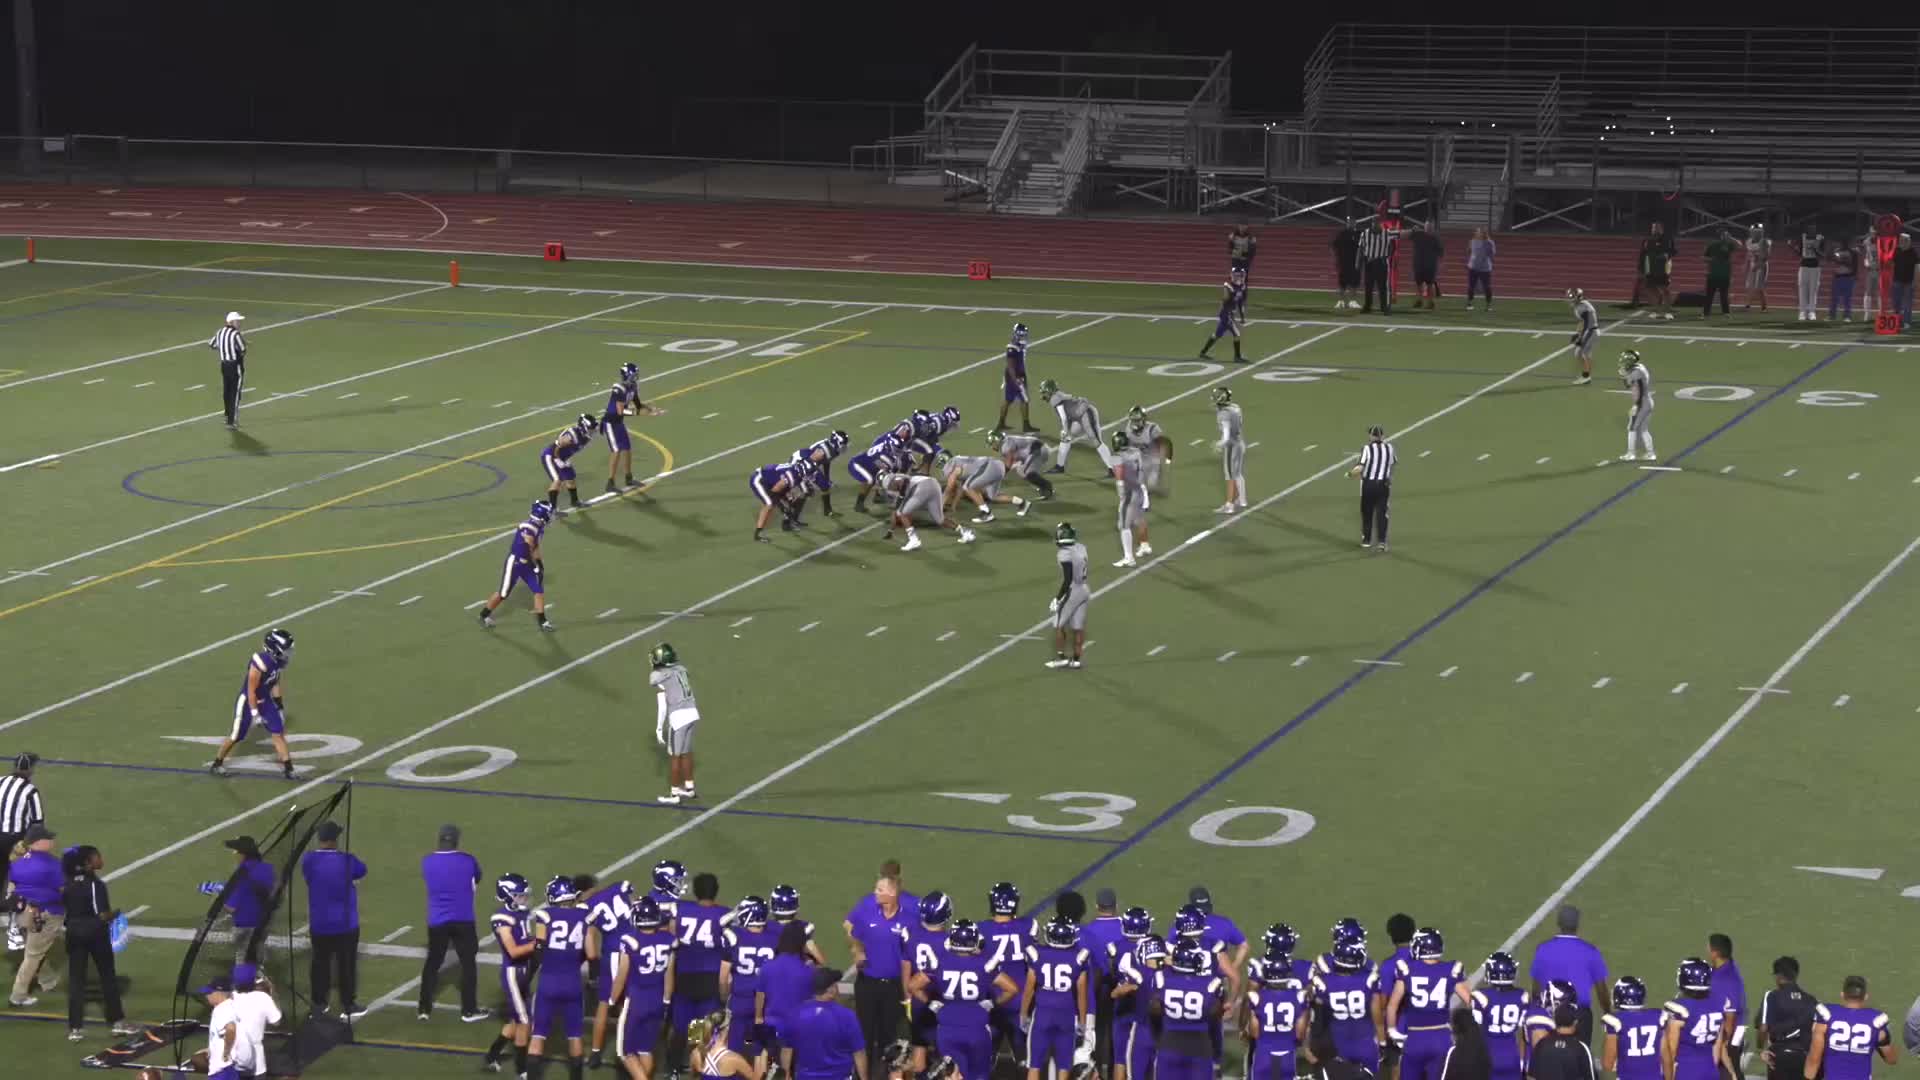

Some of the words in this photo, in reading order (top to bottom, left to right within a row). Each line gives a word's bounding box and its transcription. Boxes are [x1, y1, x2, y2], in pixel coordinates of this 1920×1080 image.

[970, 262, 986, 276] 10
[1879, 314, 1897, 330] 30
[1007, 791, 1316, 847] 30
[592, 894, 632, 932] 34
[548, 920, 584, 950] 24
[679, 916, 715, 949] 74
[992, 933, 1025, 962] 71
[639, 943, 670, 974] 35
[942, 970, 980, 1000] 76
[1041, 963, 1073, 992] 16
[1410, 975, 1448, 1009] 54
[1164, 988, 1204, 1020] 59
[1263, 1001, 1296, 1032] 13
[1328, 990, 1366, 1020] 58
[1487, 1003, 1521, 1033] 19
[1627, 1024, 1659, 1057] 17
[1690, 1011, 1724, 1044] 45
[1828, 1020, 1872, 1054] 22
